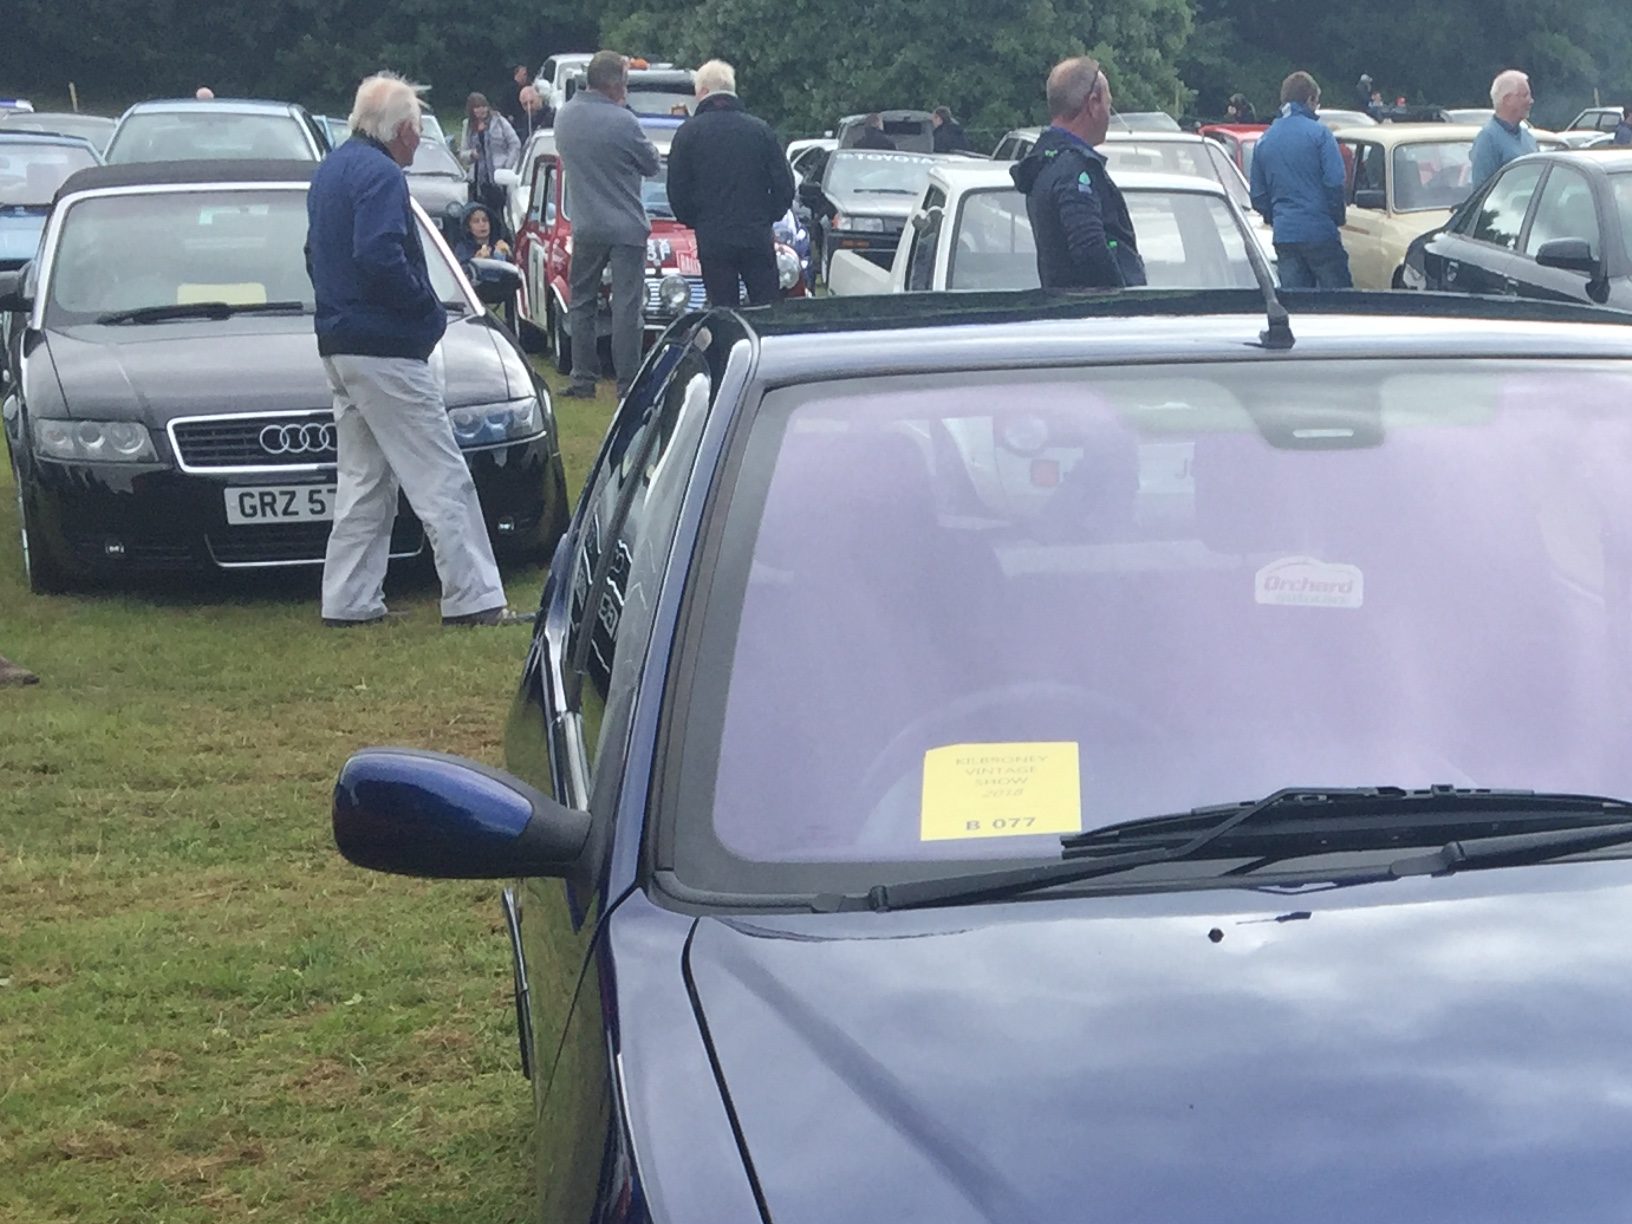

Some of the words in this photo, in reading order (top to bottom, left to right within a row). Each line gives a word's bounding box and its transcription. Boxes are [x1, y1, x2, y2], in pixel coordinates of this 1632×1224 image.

[855, 153, 935, 165] TOYOTA
[238, 490, 300, 518] GRZ
[1263, 575, 1354, 594] Orchard
[965, 765, 1037, 776] VINTAGE
[974, 777, 1029, 787] SHOW
[965, 820, 982, 832] B
[991, 816, 1037, 830] 077
